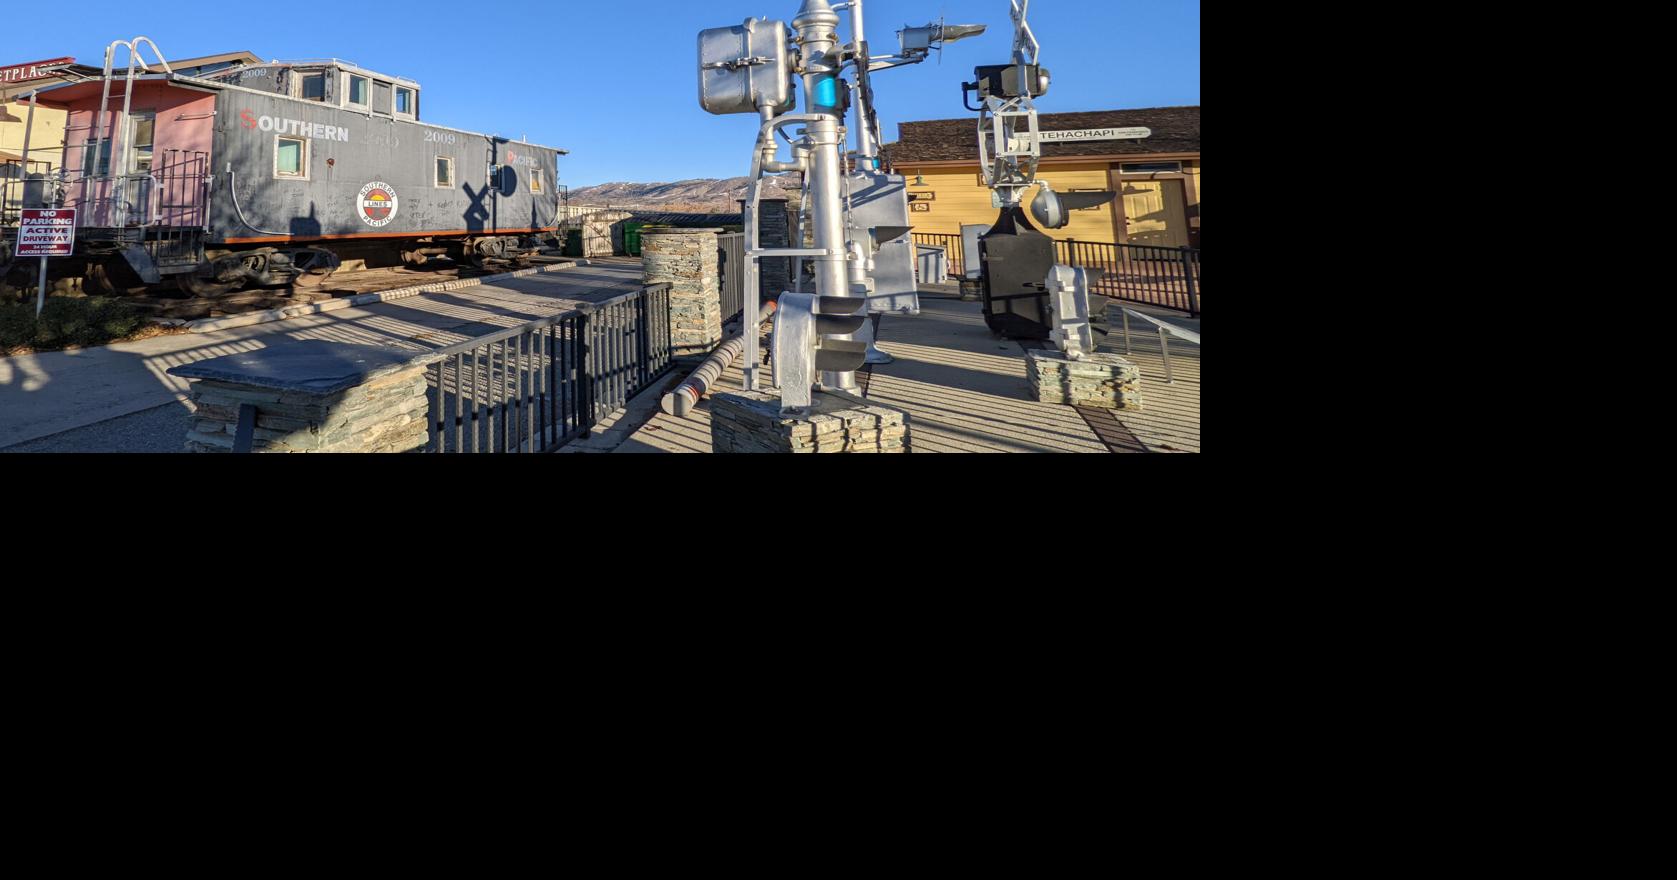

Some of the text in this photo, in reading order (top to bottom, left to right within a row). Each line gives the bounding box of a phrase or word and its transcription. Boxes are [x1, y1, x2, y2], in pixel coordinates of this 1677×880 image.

[242, 68, 267, 78] 2009
[240, 108, 349, 142] SOUTHERN
[424, 130, 456, 145] 2009
[1040, 129, 1115, 139] TEHACHAPI
[507, 150, 538, 167] PACIFIC
[360, 181, 396, 198] SOUTHERN
[363, 215, 392, 227] PACIFIC
